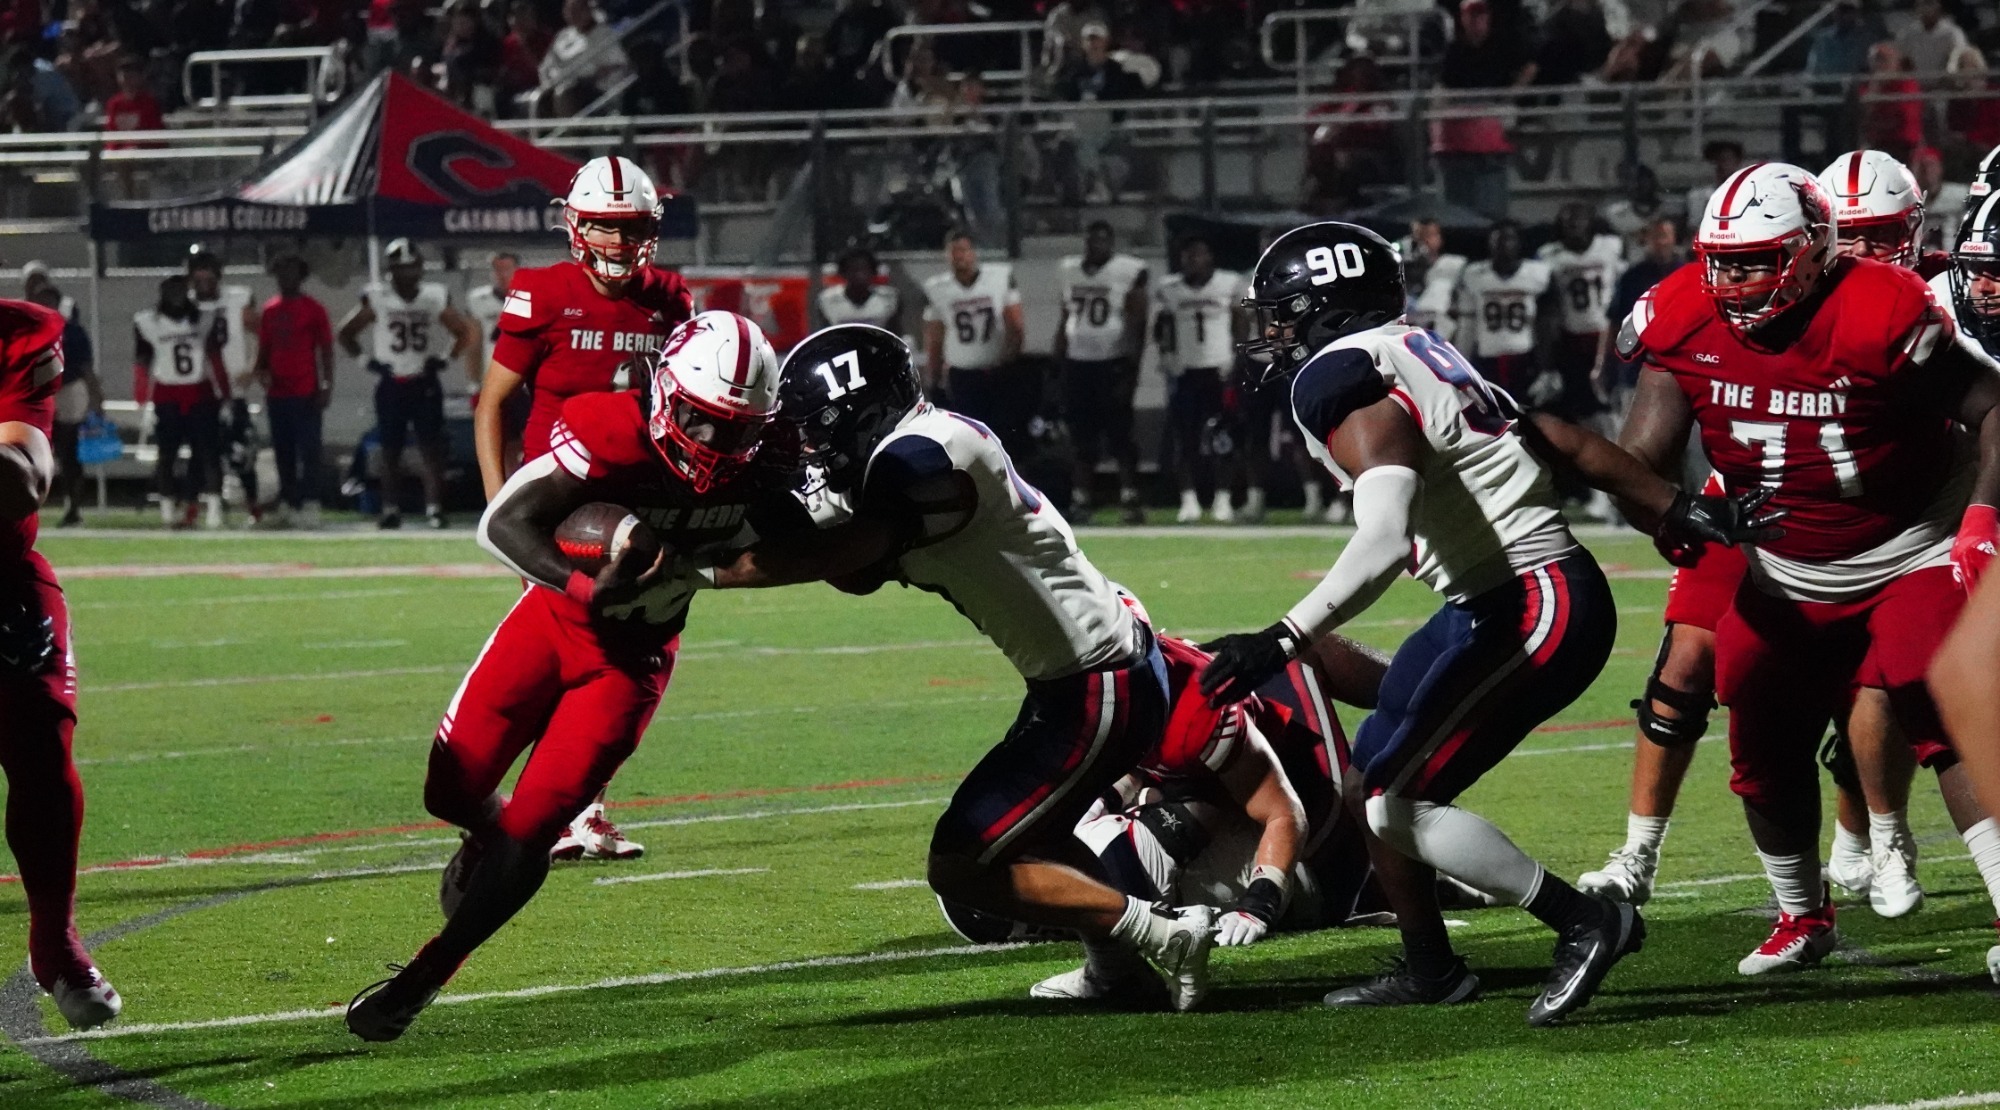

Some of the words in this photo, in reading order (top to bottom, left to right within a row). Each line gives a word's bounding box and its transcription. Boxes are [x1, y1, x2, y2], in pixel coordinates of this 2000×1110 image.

[1838, 207, 1867, 216] Riddell
[1709, 232, 1736, 240] Riddell
[1962, 244, 1989, 252] Riddell
[1305, 243, 1366, 286] 90
[564, 308, 583, 316] SAC
[955, 306, 995, 344] 67
[1071, 296, 1109, 327] 70
[387, 321, 429, 352] 35
[571, 329, 604, 350] THE
[174, 343, 194, 375] 6
[1695, 352, 1720, 363] SAC
[815, 350, 867, 401] 17
[1709, 379, 1754, 409] THE
[1767, 388, 1848, 417] BERRY
[1729, 418, 1864, 498] 71
[686, 504, 751, 530] BERR
